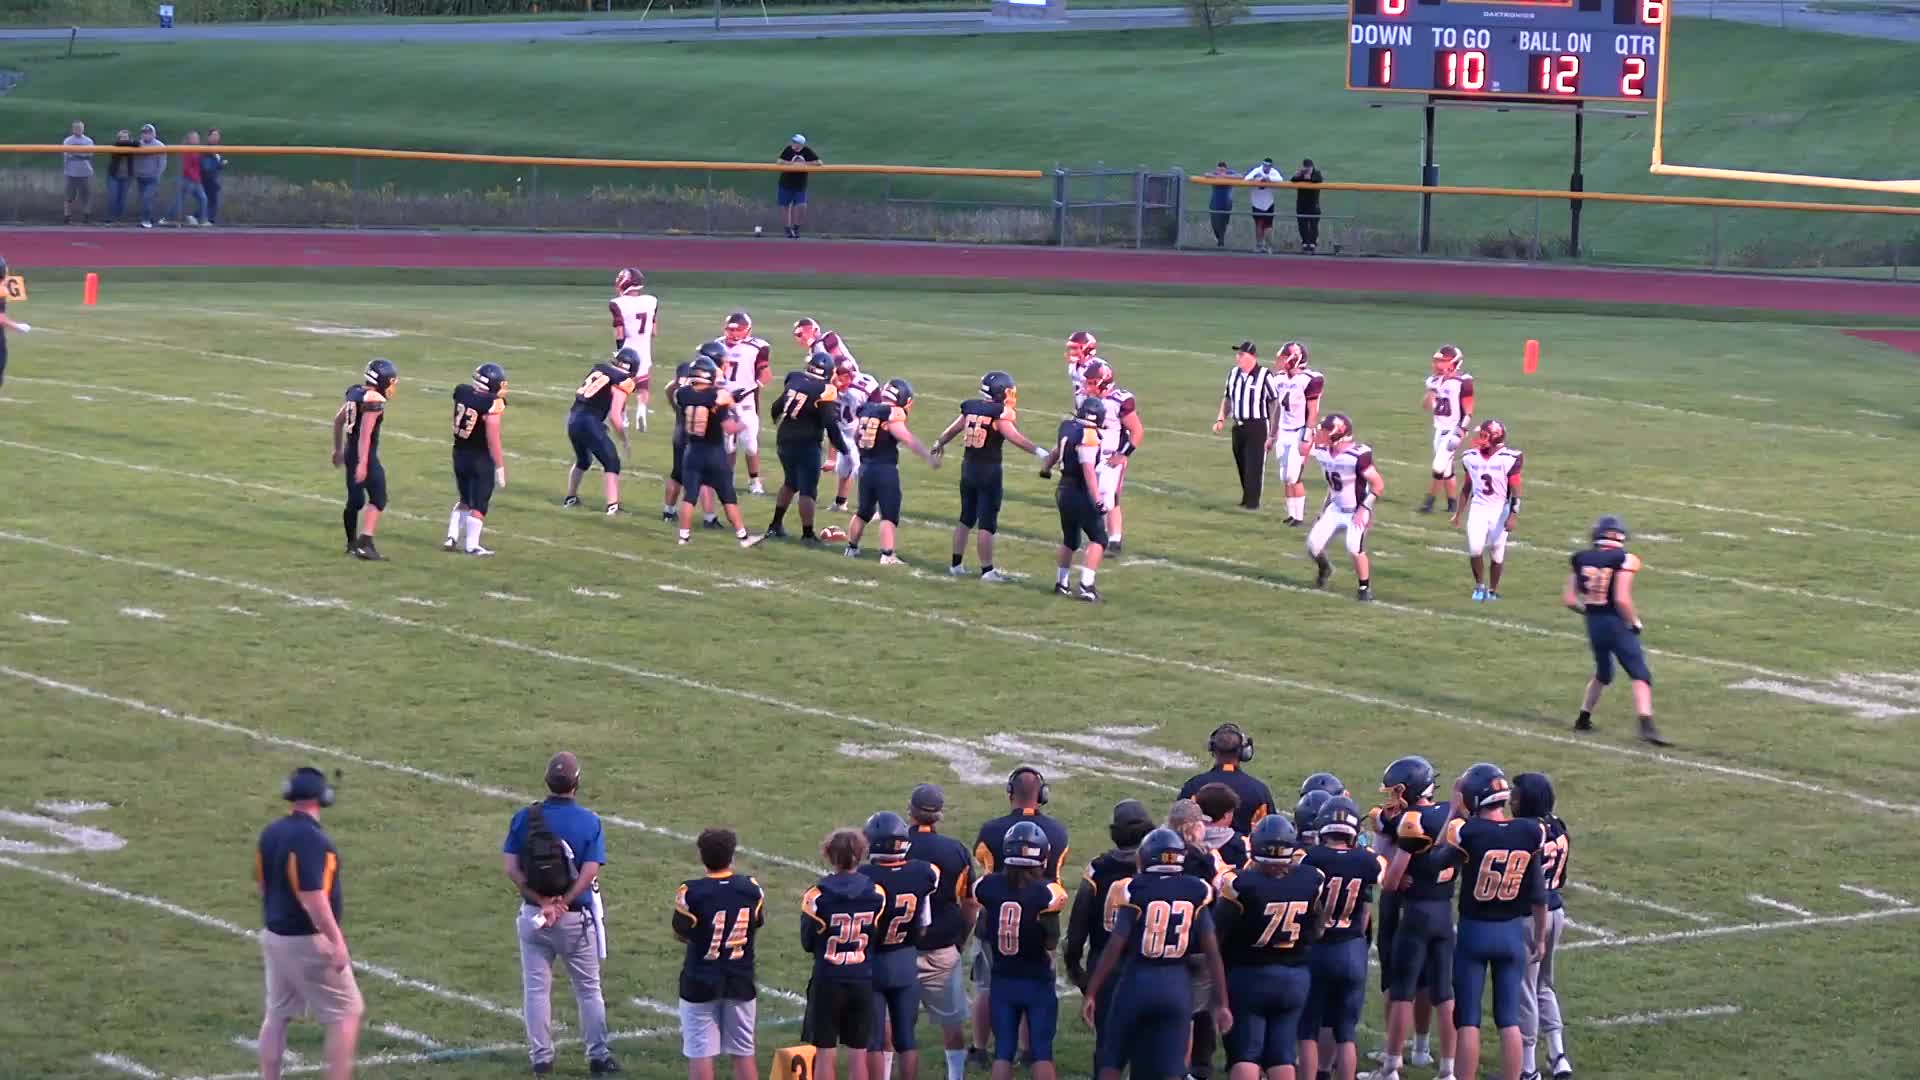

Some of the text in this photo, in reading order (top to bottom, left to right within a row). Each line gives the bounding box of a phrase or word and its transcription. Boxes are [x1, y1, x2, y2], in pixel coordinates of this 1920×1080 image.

[1482, 11, 1536, 19] DAKTRONICS
[1351, 24, 1412, 46] DOWN
[1431, 27, 1491, 49] TO GO
[1519, 31, 1592, 53] BALL ON
[1615, 34, 1656, 56] QTR
[1383, 50, 1392, 83] 1
[1448, 51, 1485, 90] 10
[1542, 55, 1579, 93] 12
[1622, 57, 1646, 96] 2
[7, 278, 21, 298] G
[635, 312, 648, 335] 7
[783, 388, 808, 420] 77
[1480, 473, 1495, 496] 3
[1473, 849, 1531, 901] 68
[883, 893, 918, 946] 2
[1324, 876, 1362, 928] 11
[704, 906, 751, 961] 14
[823, 911, 875, 966] 25
[997, 901, 1022, 957] 8
[1141, 900, 1195, 959] 83
[1253, 901, 1309, 949] 75
